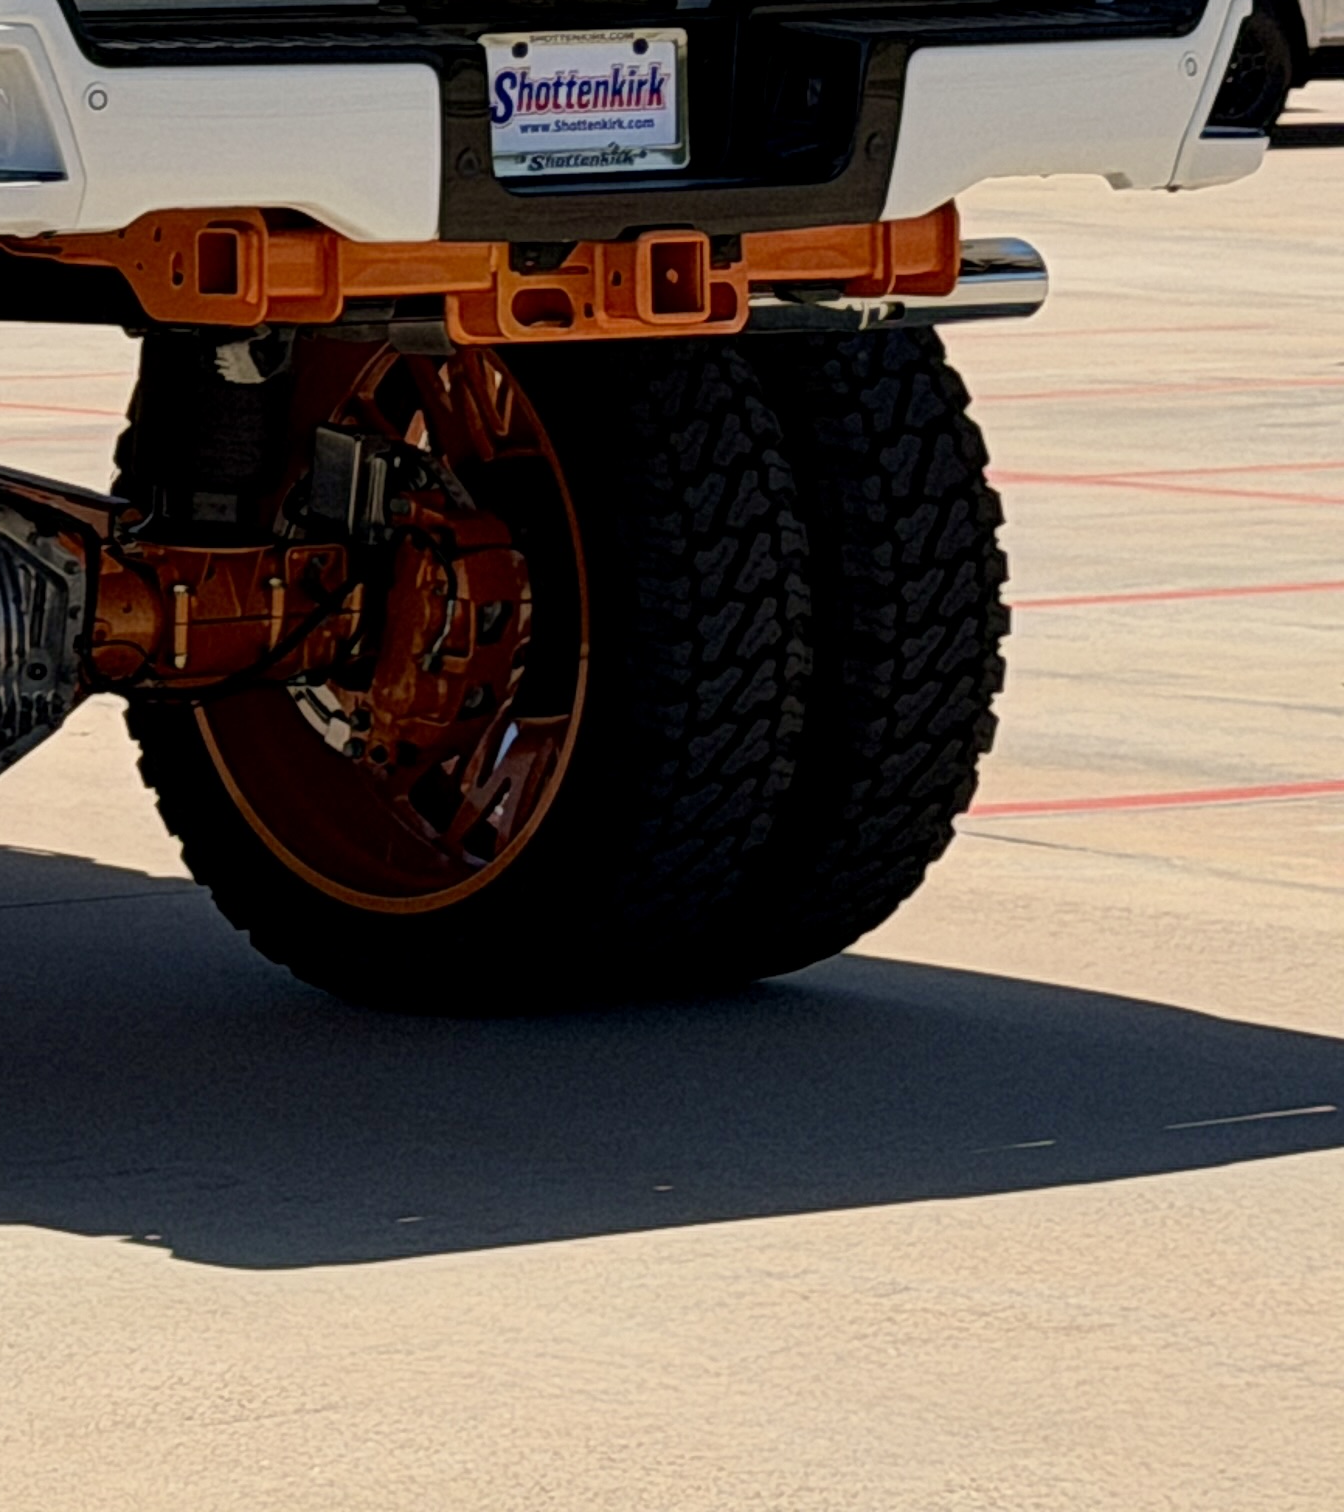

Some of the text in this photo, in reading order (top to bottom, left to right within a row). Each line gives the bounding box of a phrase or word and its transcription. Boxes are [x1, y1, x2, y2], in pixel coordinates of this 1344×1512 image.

[490, 62, 667, 125] Shottenkirk
[519, 118, 655, 134] www.Shottenkirk.com
[527, 148, 637, 171] Shottenkirk
